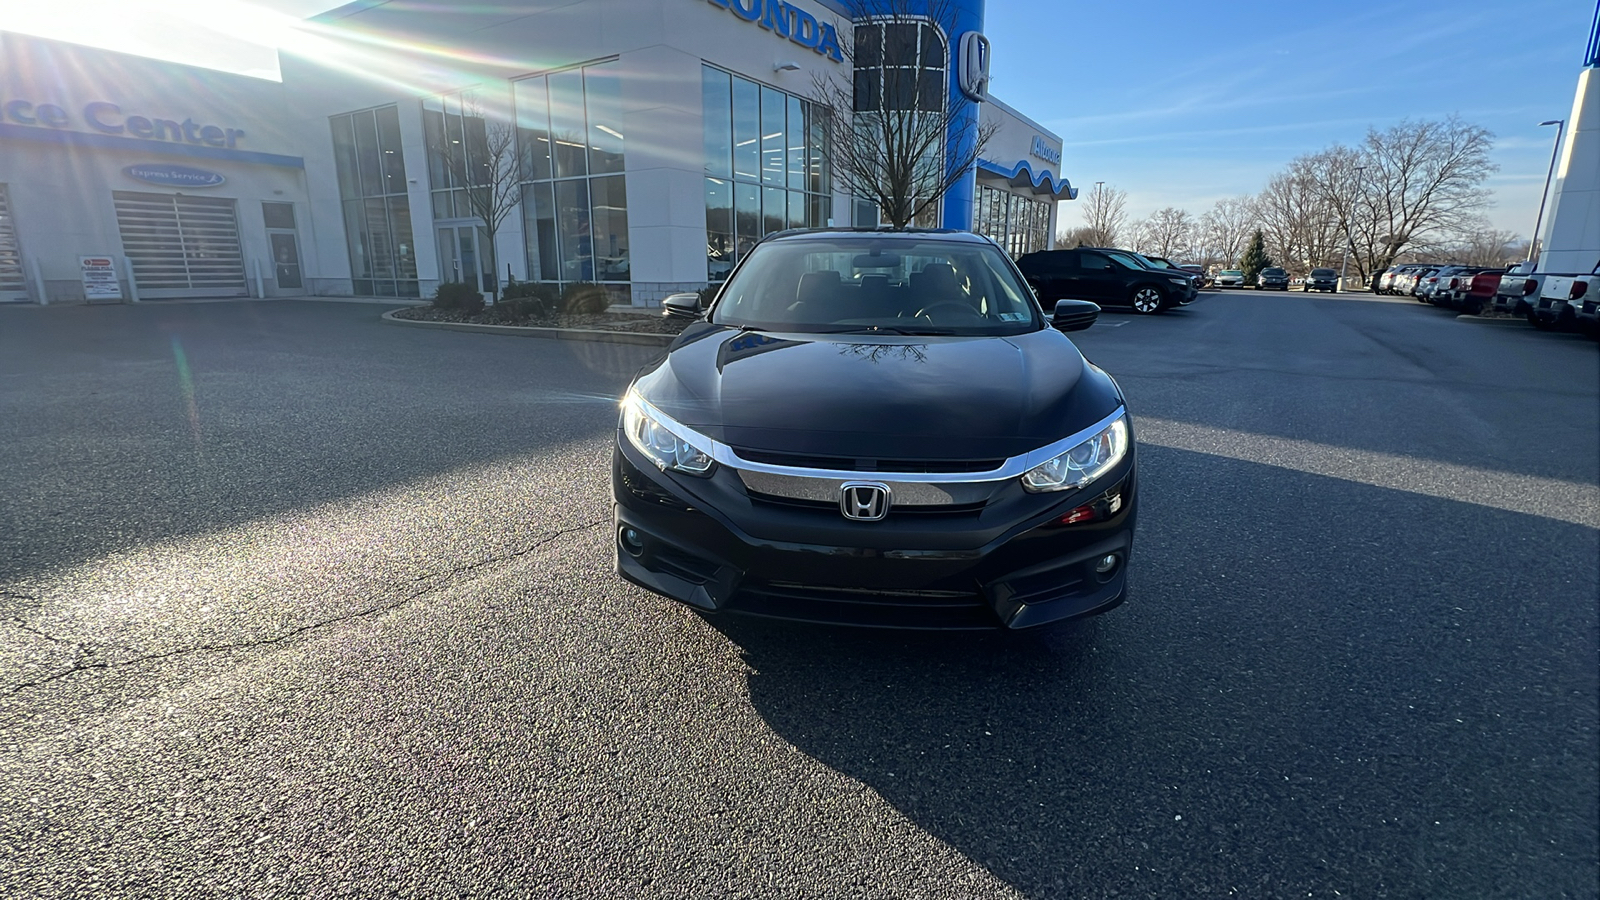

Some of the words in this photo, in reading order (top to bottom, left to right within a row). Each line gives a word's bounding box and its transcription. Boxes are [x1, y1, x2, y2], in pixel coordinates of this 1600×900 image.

[707, 0, 844, 63] ONDA
[0, 99, 68, 127] ce
[83, 101, 244, 147] Center
[131, 168, 169, 178] Express
[171, 171, 205, 180] Service
